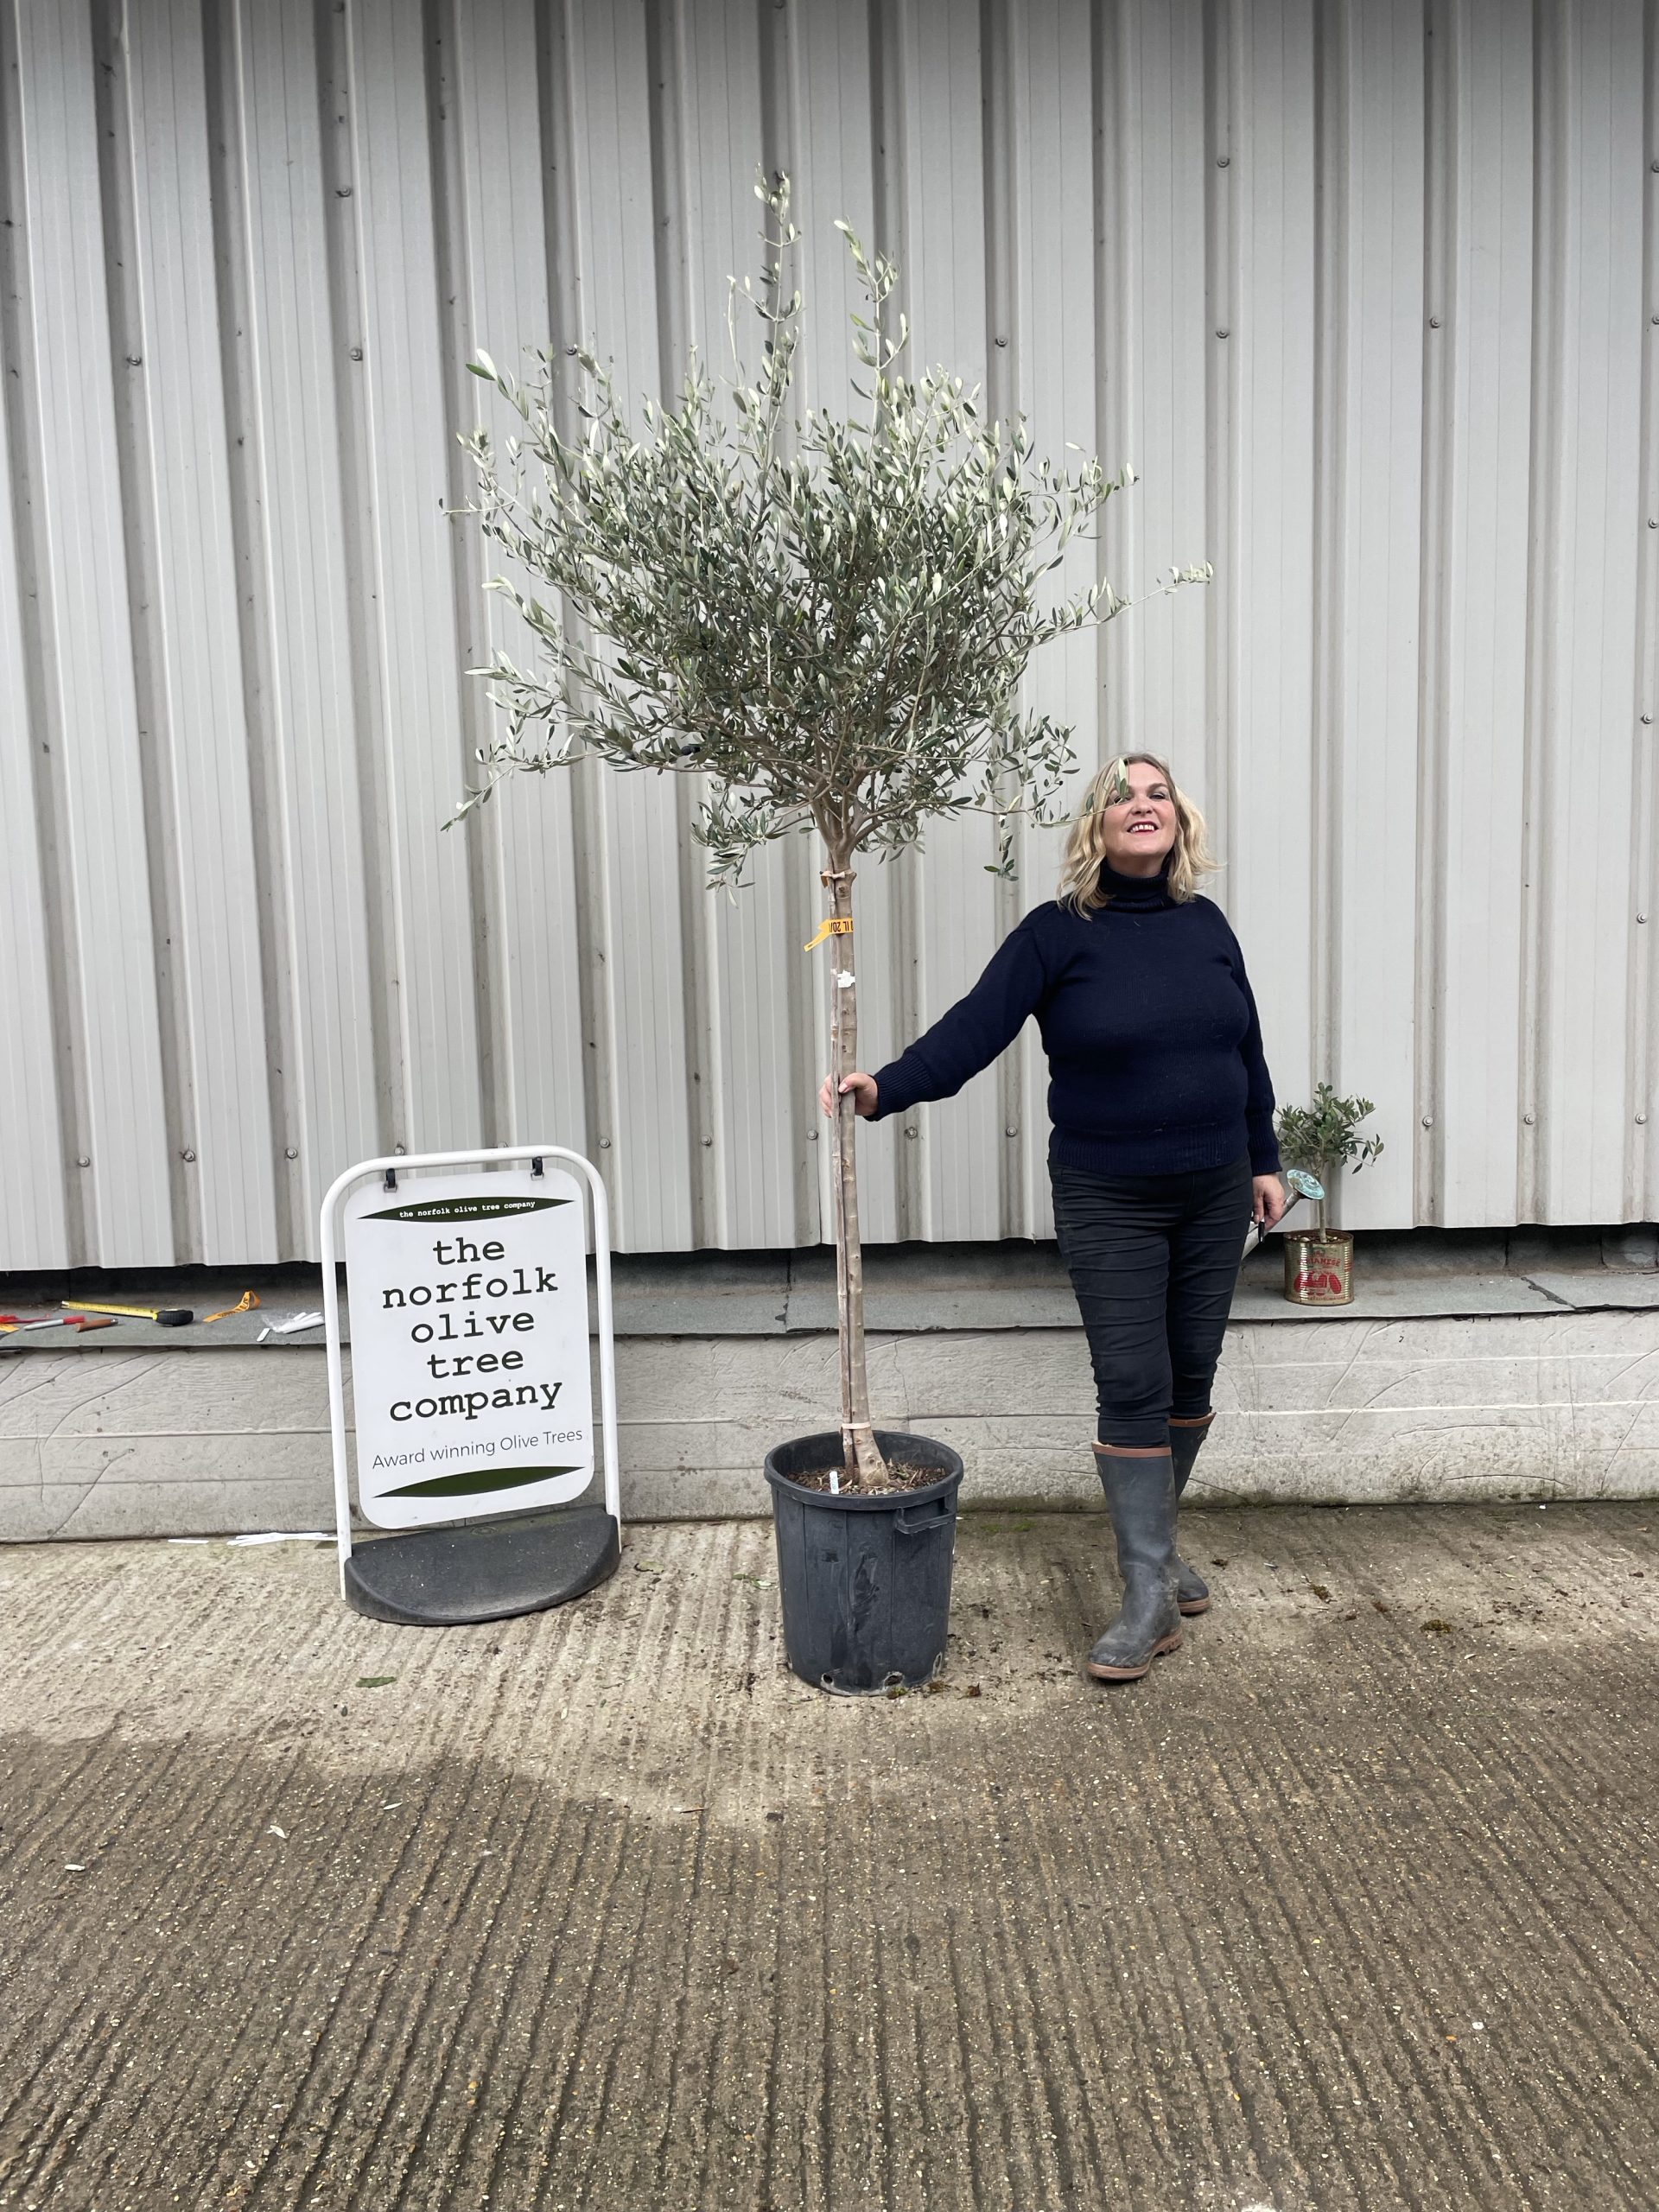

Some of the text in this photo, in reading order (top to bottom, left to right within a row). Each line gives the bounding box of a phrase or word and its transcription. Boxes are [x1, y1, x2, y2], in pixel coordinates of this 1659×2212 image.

[399, 1210, 414, 1218] the
[417, 1208, 451, 1217] norfolk
[504, 1200, 536, 1210] company
[433, 1237, 505, 1265] the
[383, 1267, 559, 1308] norfolk
[411, 1311, 535, 1343] olive
[427, 1350, 524, 1379] tree
[390, 1382, 563, 1421] company
[372, 1429, 582, 1470] Award winning Olive Trees
